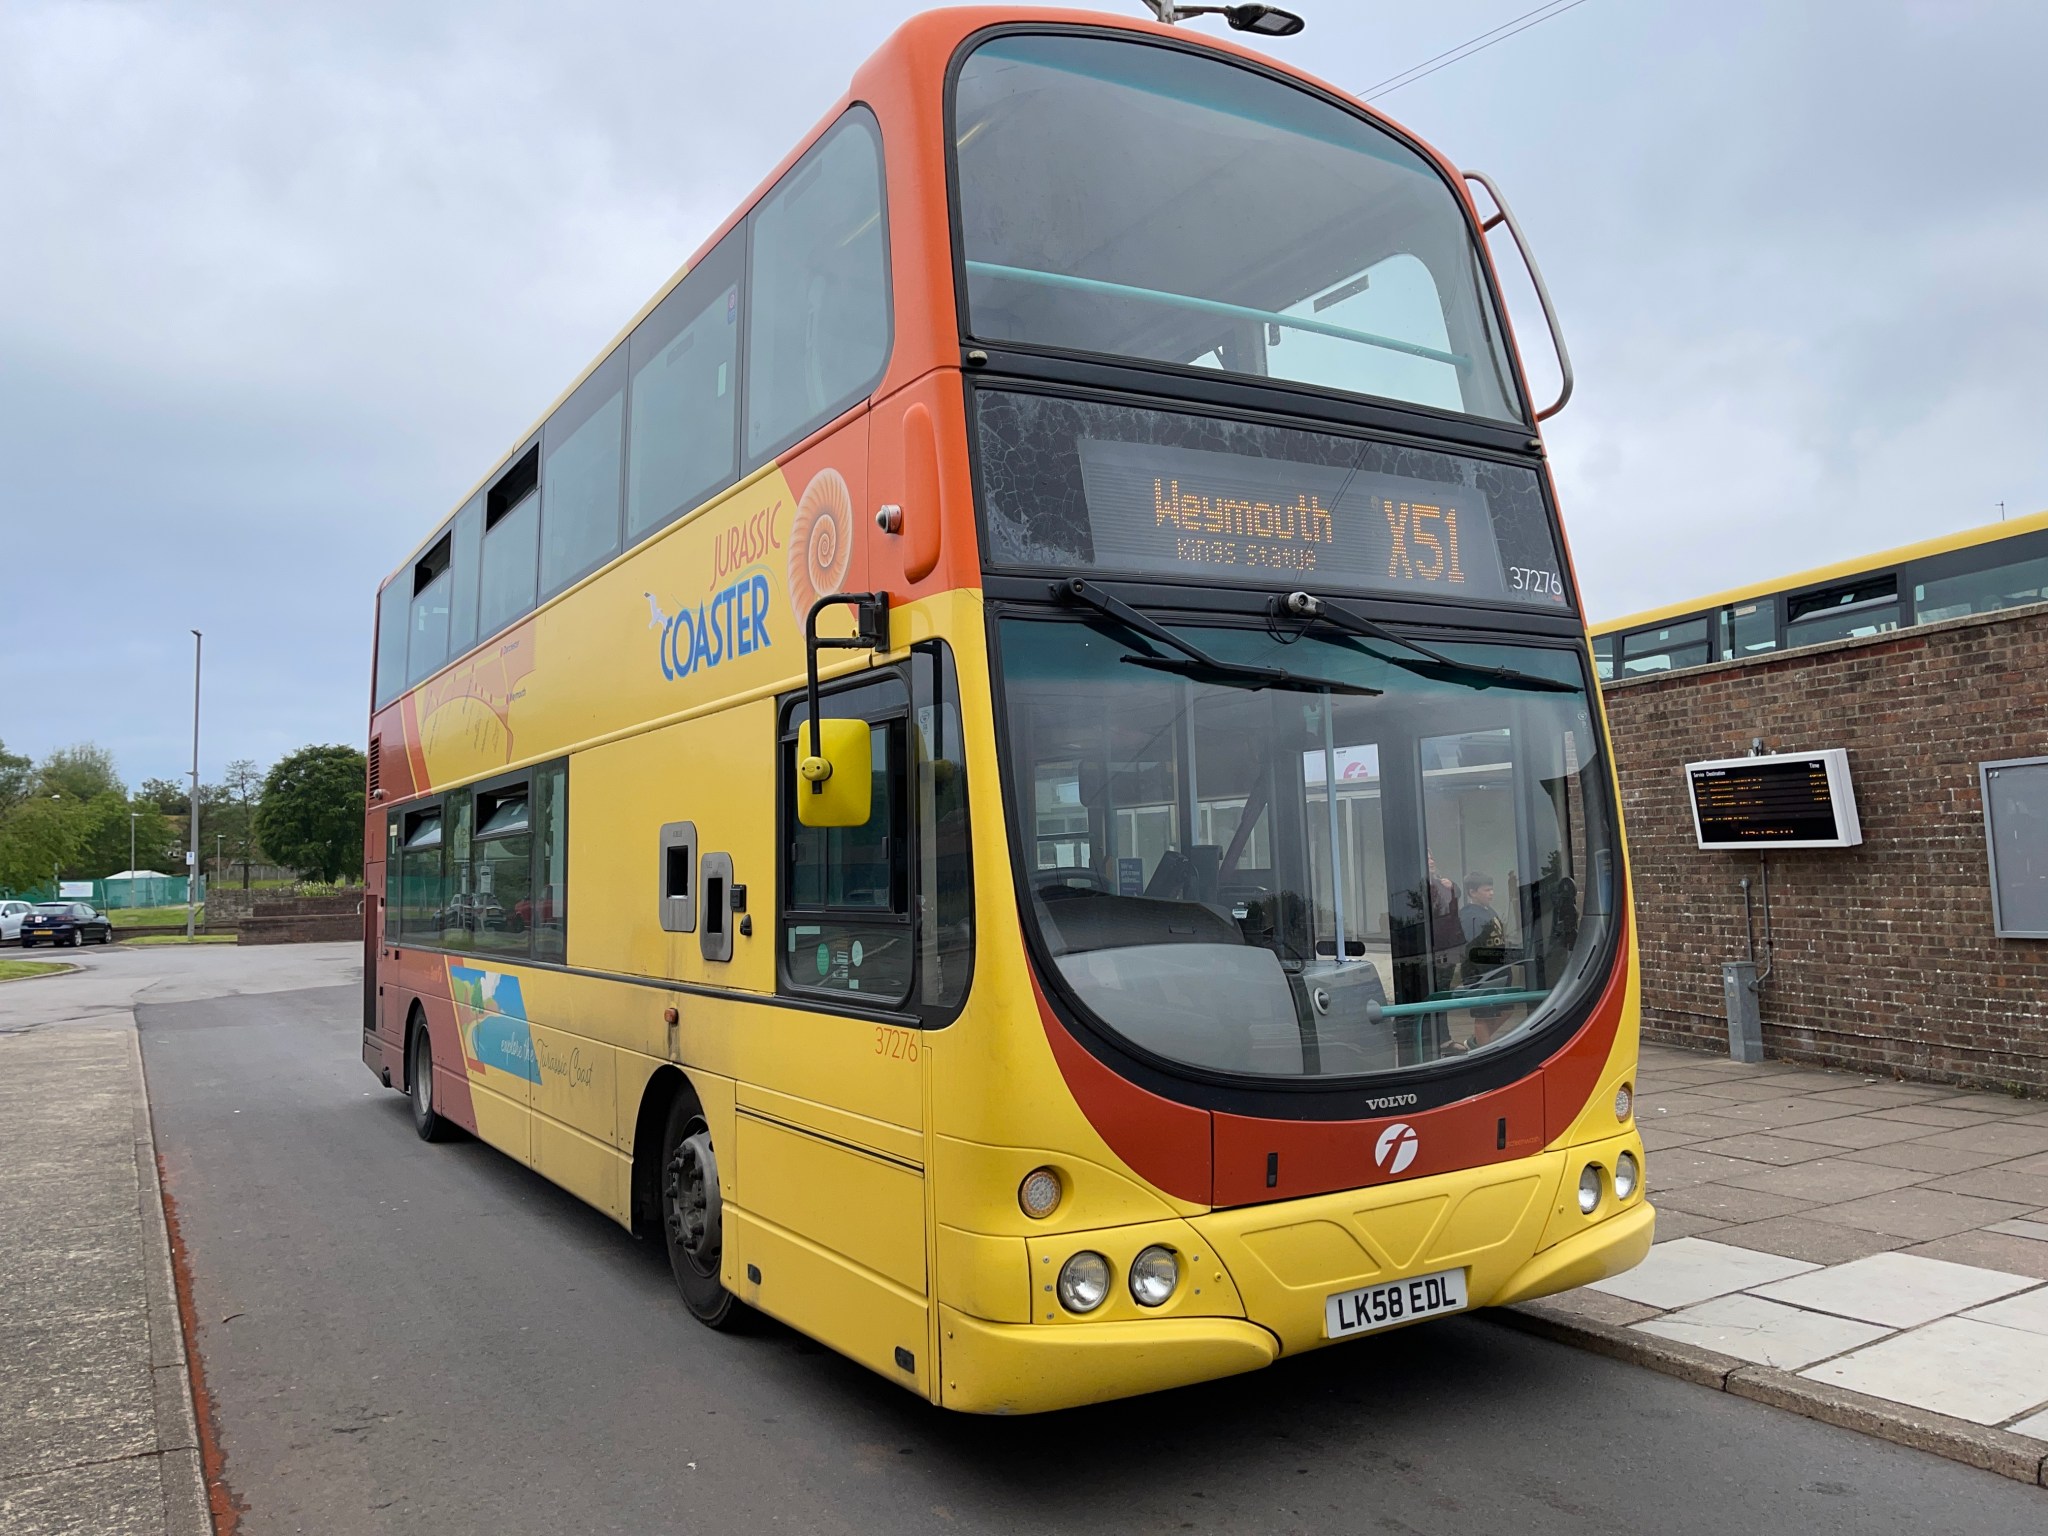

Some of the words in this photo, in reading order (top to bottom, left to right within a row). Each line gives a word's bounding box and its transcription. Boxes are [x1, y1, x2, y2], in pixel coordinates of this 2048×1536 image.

[1154, 478, 1333, 544] Weymouth
[710, 500, 782, 592] JURASSIC
[1384, 500, 1465, 583] X51
[1509, 566, 1562, 595] 37276
[660, 573, 772, 682] COASTER
[874, 1026, 919, 1063] 37276
[1366, 1093, 1418, 1111] VOLVO
[1337, 1286, 1404, 1331] LK58
[1408, 1276, 1457, 1314] EDL
